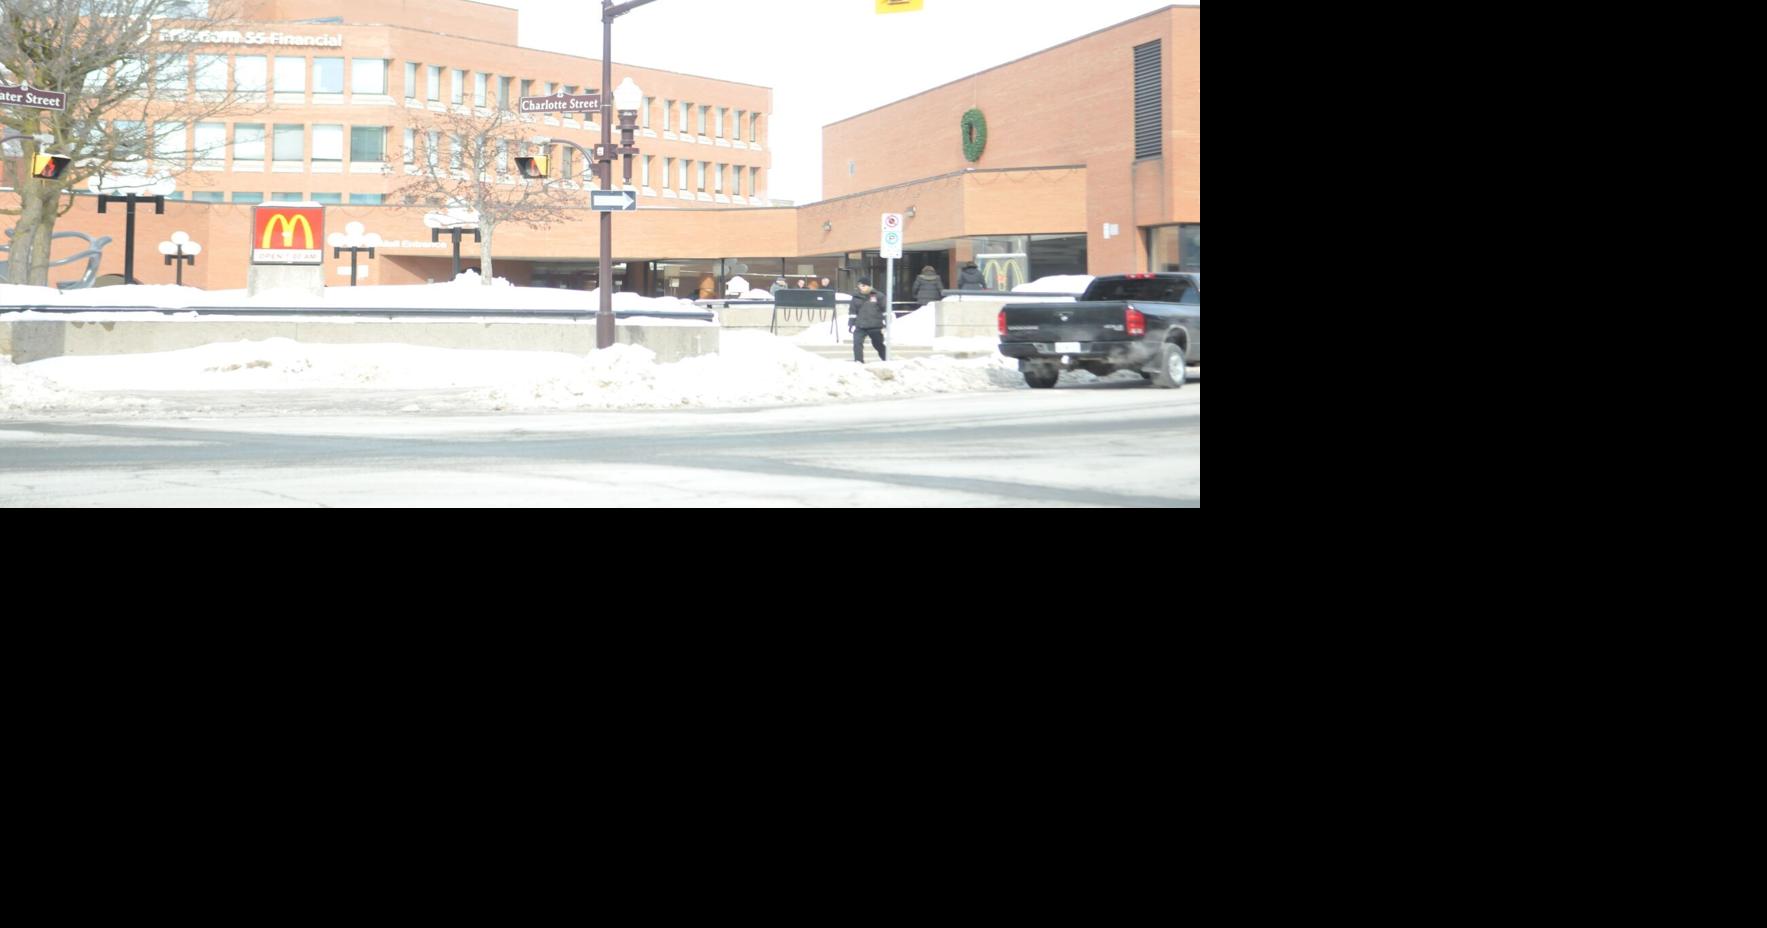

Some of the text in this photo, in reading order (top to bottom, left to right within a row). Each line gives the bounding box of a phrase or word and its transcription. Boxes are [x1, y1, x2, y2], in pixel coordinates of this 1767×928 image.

[270, 32, 342, 46] Financial
[0, 92, 61, 107] ater Street
[522, 98, 598, 111] Charlotte Street
